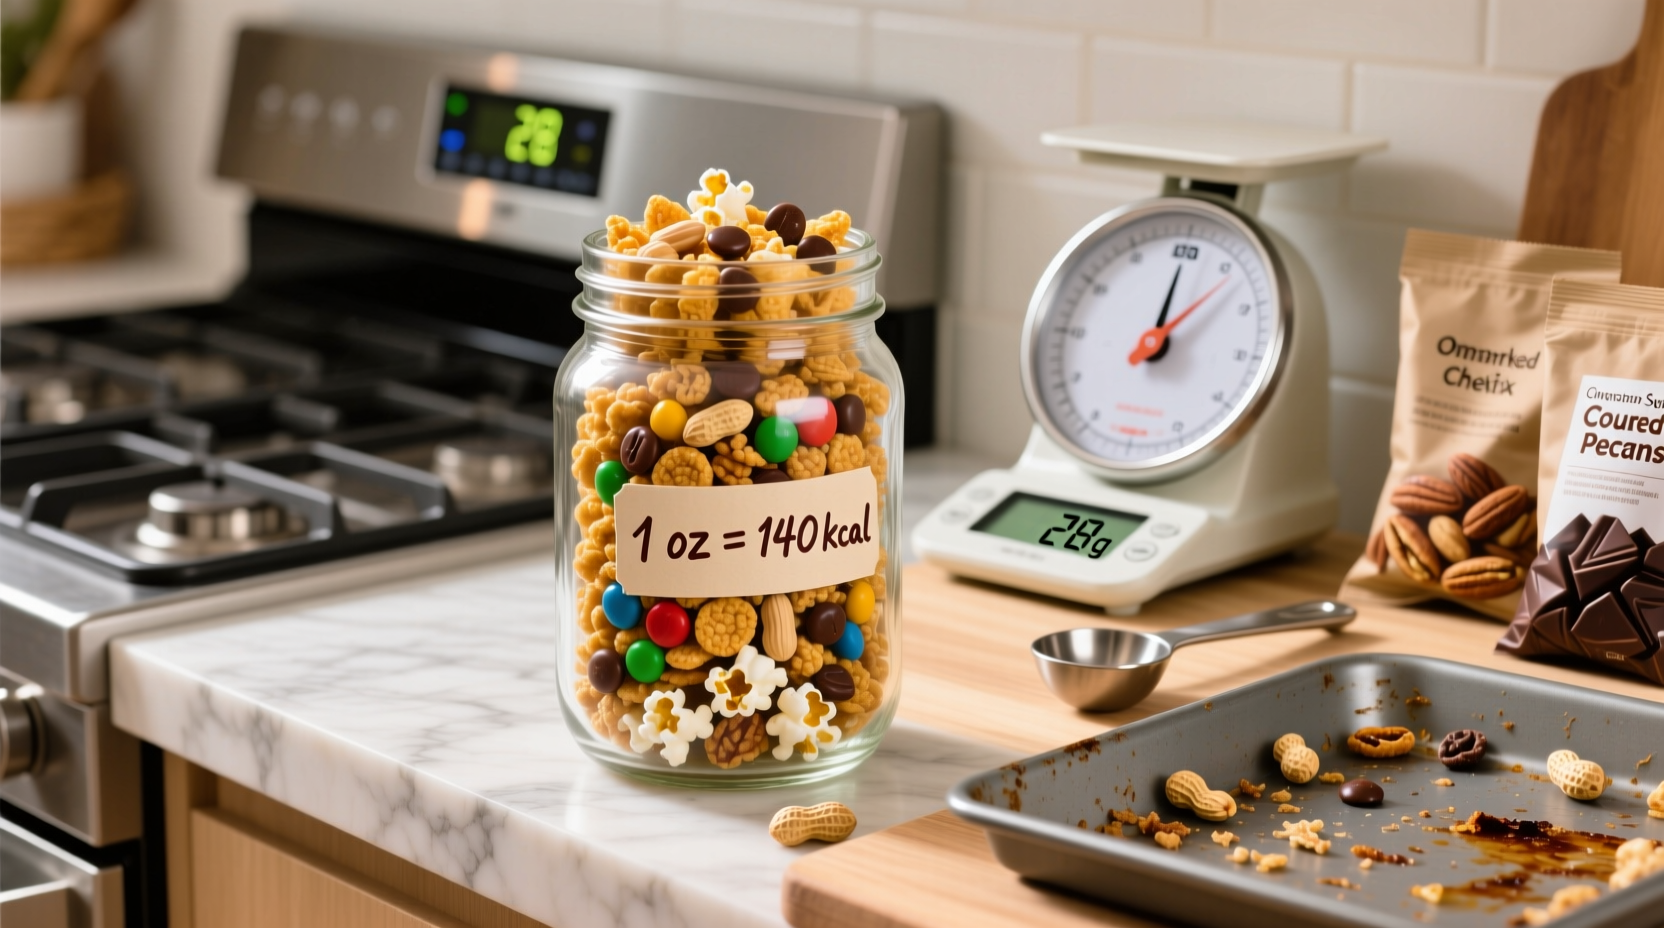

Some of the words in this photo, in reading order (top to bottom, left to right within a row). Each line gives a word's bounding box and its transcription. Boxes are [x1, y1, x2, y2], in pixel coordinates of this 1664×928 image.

[505, 104, 563, 167] 28
[1583, 405, 1664, 435] Coured
[1580, 432, 1664, 464] Pecans
[632, 515, 653, 563] 1
[666, 531, 711, 561] oz
